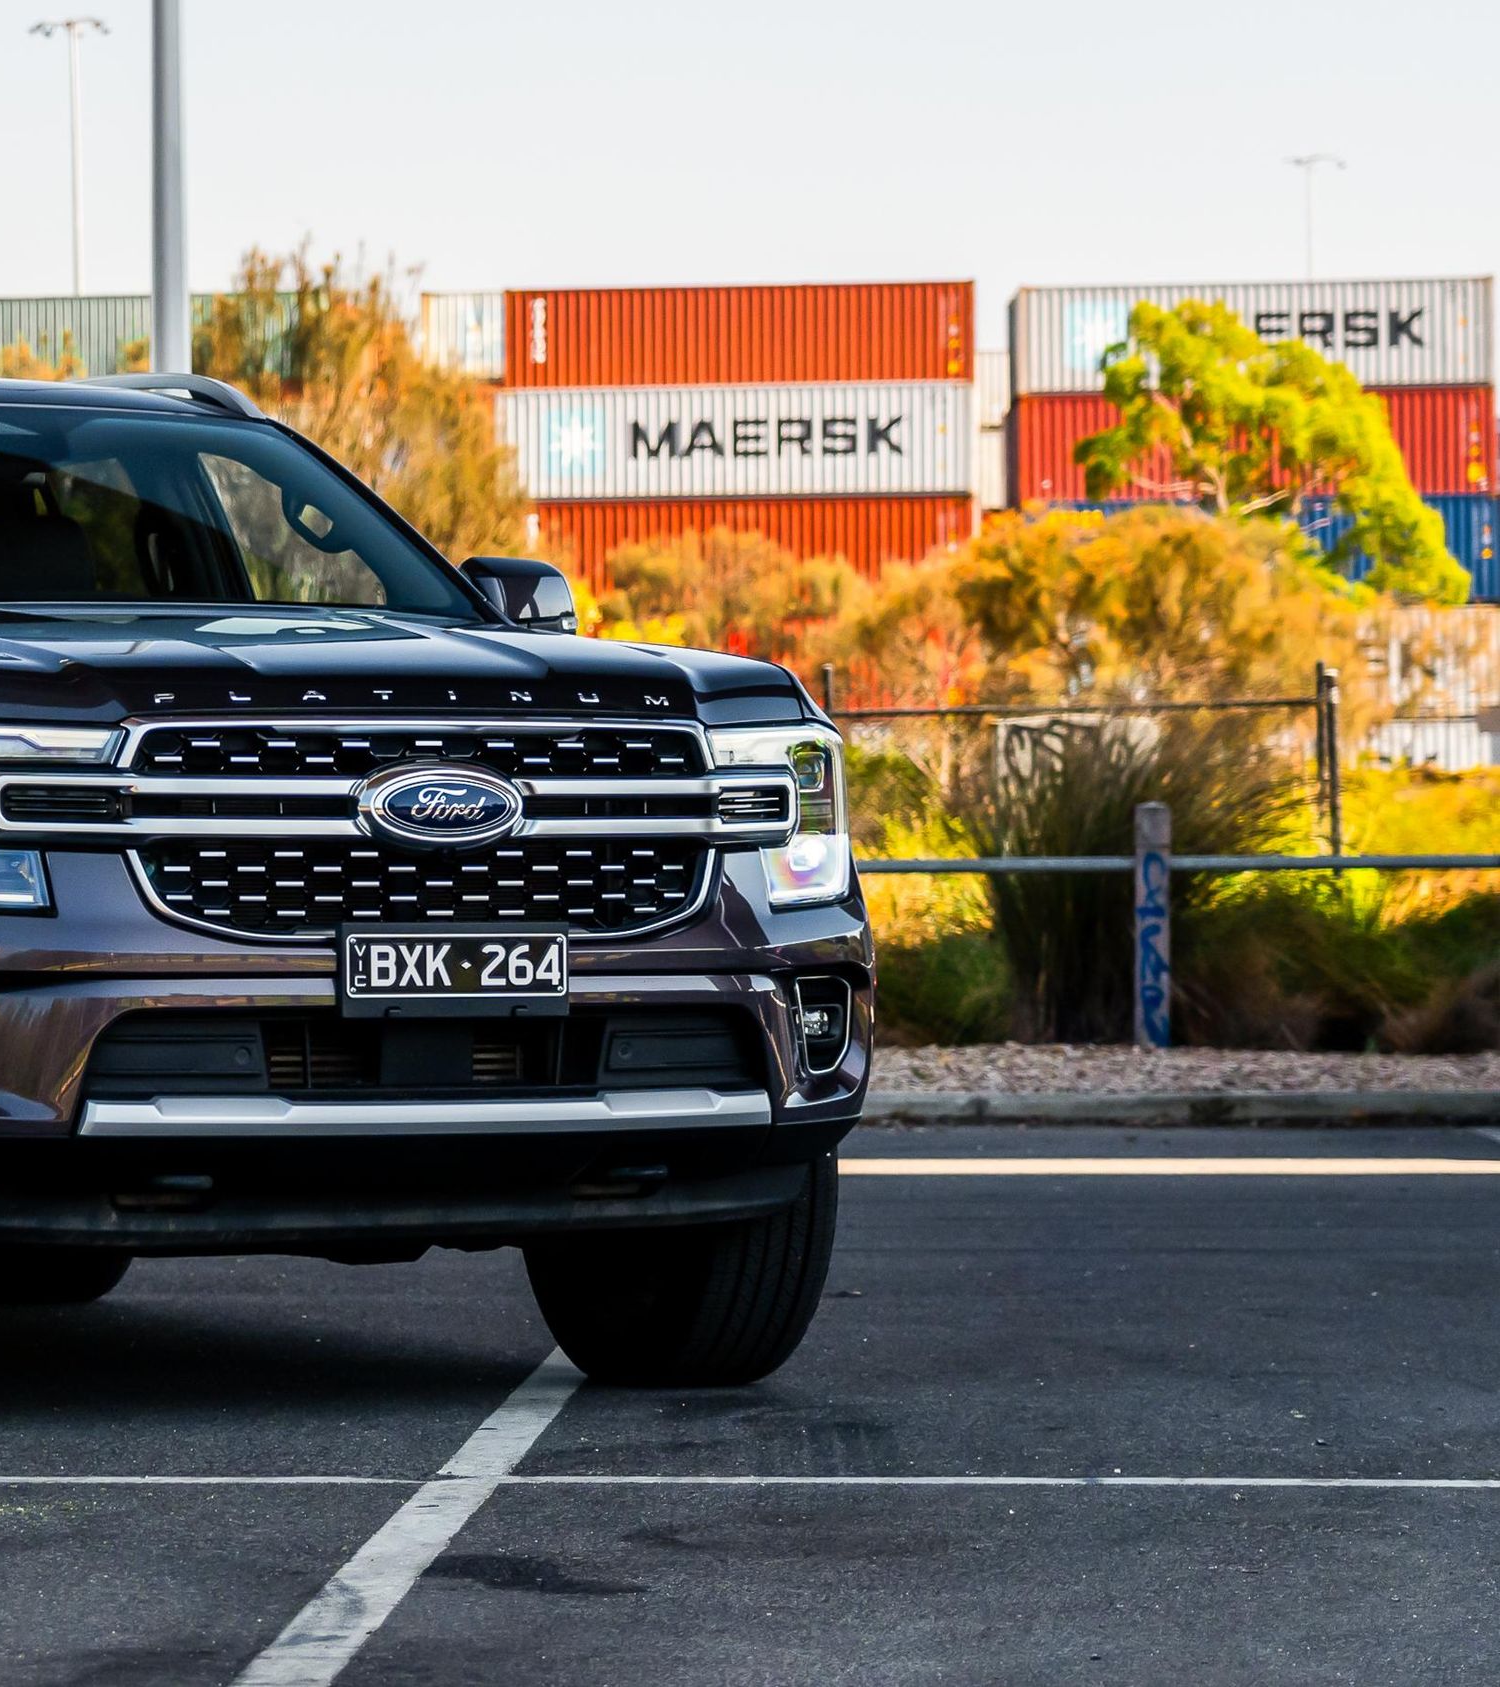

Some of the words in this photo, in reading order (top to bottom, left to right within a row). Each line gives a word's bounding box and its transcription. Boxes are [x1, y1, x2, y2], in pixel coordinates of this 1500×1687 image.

[1255, 305, 1423, 348] ERSK
[629, 415, 904, 457] MAERSK
[153, 690, 670, 706] PLATINUM
[411, 787, 486, 820] Ford
[354, 944, 367, 987] VIC
[370, 944, 452, 987] BXK
[481, 944, 561, 986] 264
